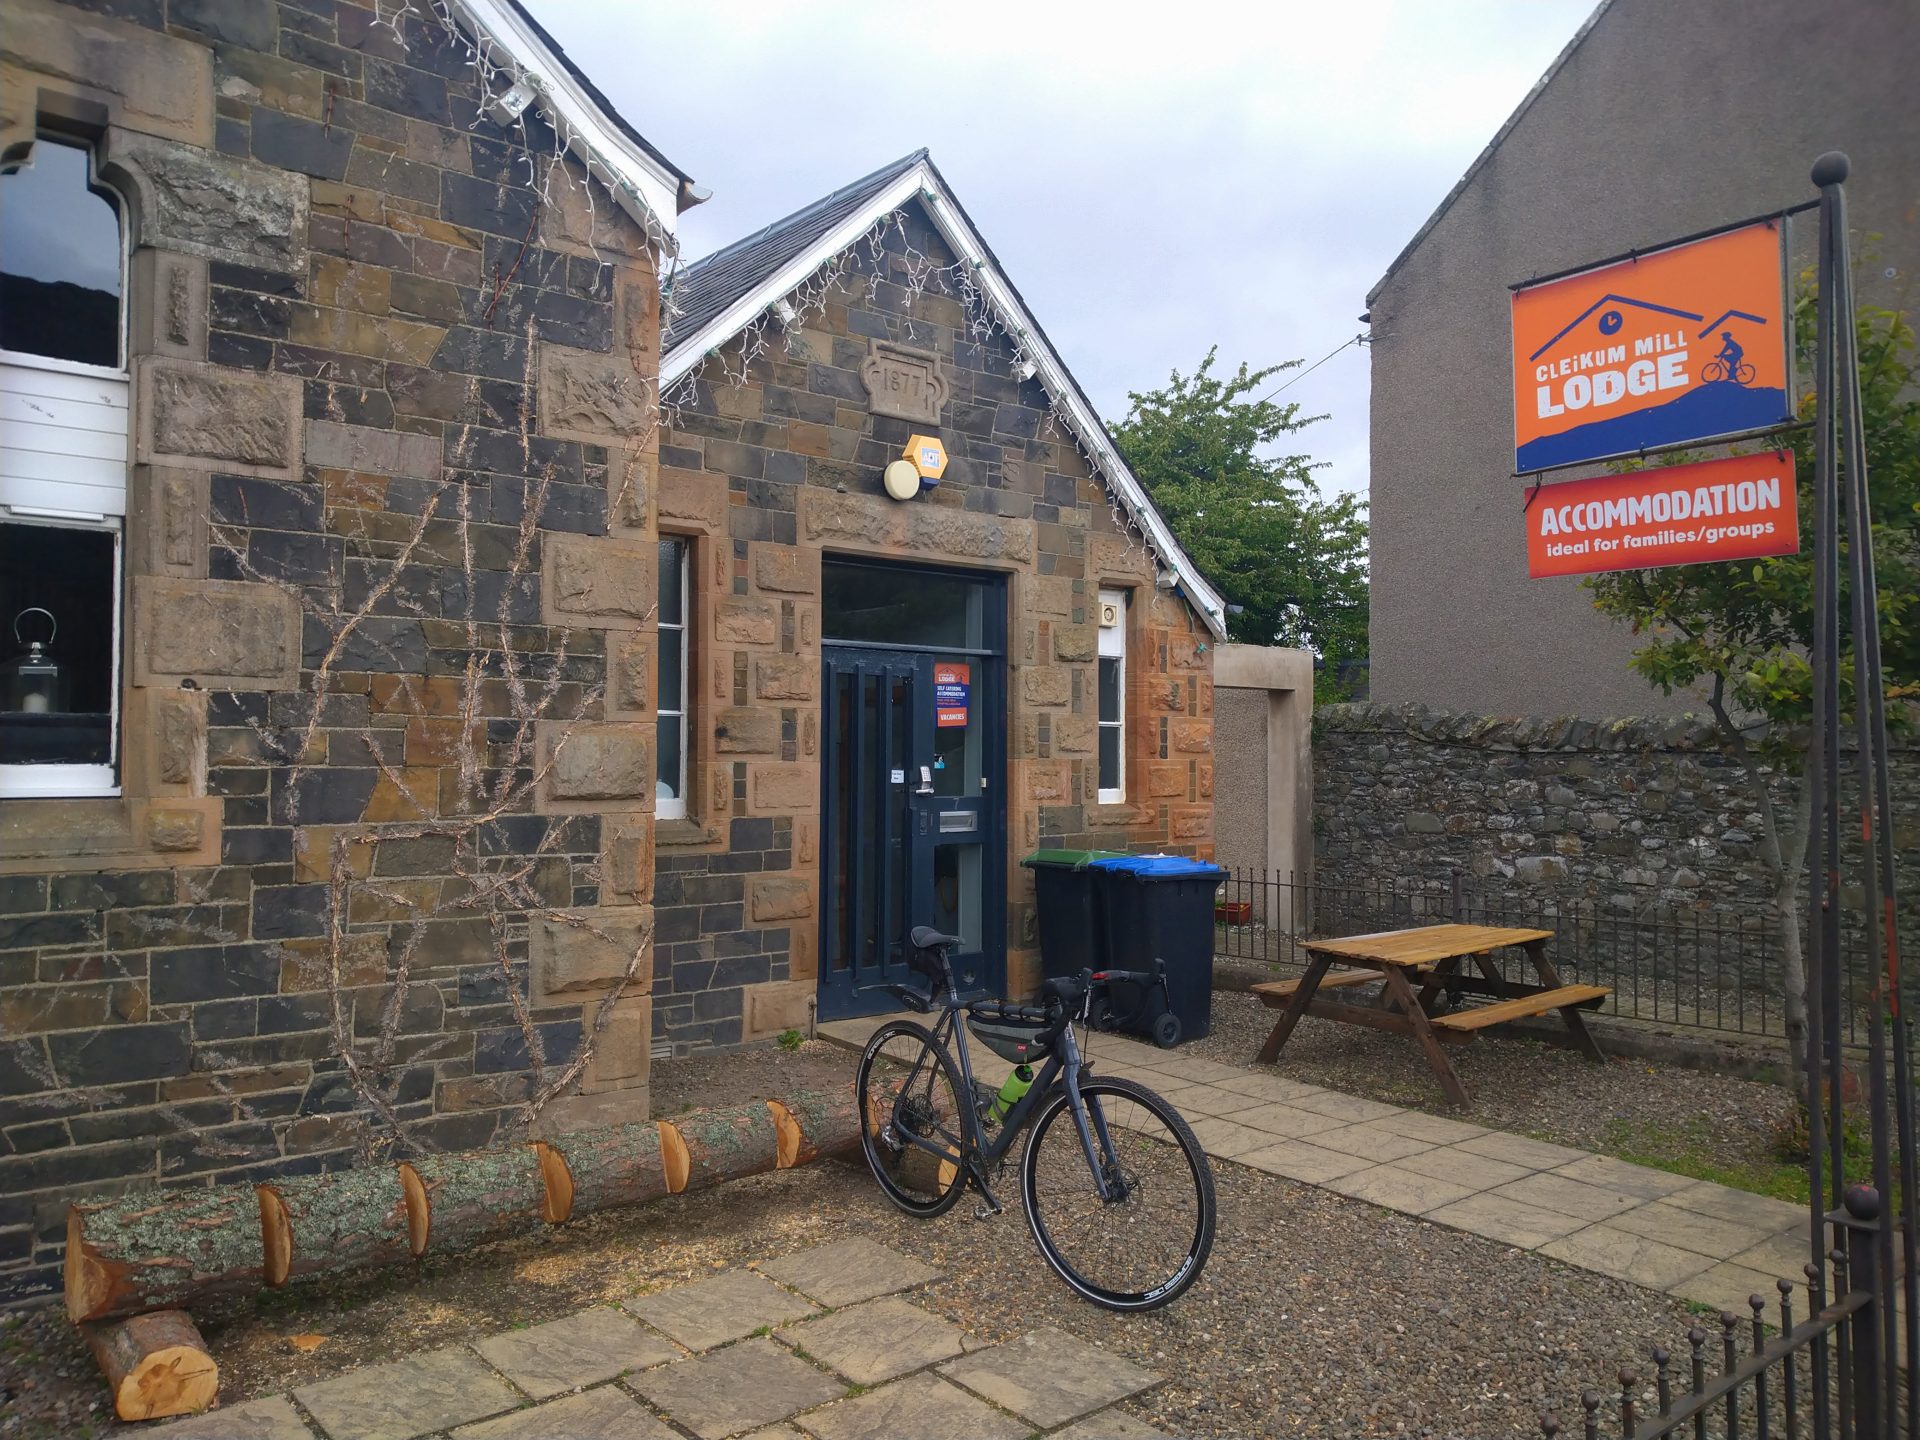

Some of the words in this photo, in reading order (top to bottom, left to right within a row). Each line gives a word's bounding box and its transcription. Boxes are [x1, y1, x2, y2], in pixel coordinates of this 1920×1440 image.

[884, 368, 921, 397] 1877
[1537, 351, 1689, 418] LODGE
[1540, 478, 1780, 536] ACCOMMODATION
[1547, 539, 1589, 557] ideal
[1594, 535, 1619, 551] for
[1623, 522, 1775, 549] families/groups
[1144, 1286, 1164, 1300] DISC
